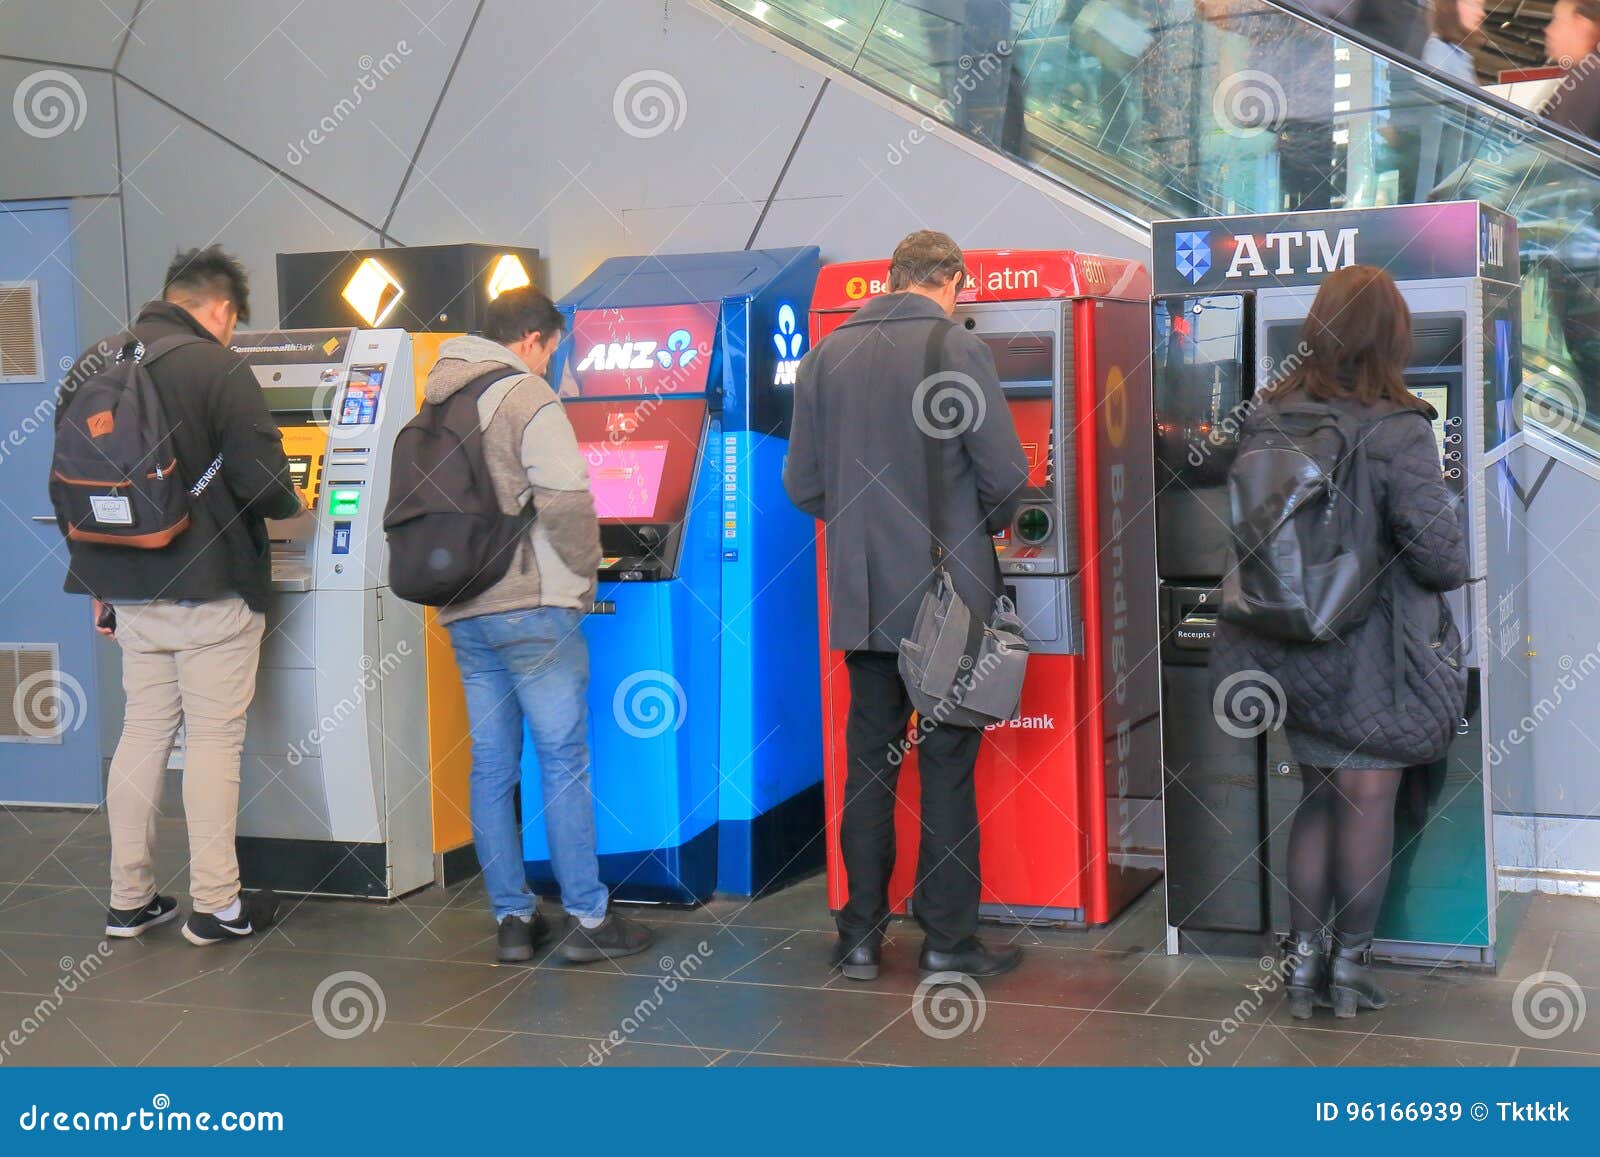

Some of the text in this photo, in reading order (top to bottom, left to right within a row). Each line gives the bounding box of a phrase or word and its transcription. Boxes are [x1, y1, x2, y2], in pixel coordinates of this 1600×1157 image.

[1226, 228, 1359, 278] ATM
[987, 266, 1039, 291] atm
[576, 341, 658, 371] ANZ
[190, 451, 224, 496] SHENGZH
[1110, 464, 1128, 705] Bendigo
[1178, 630, 1211, 639] Receipts
